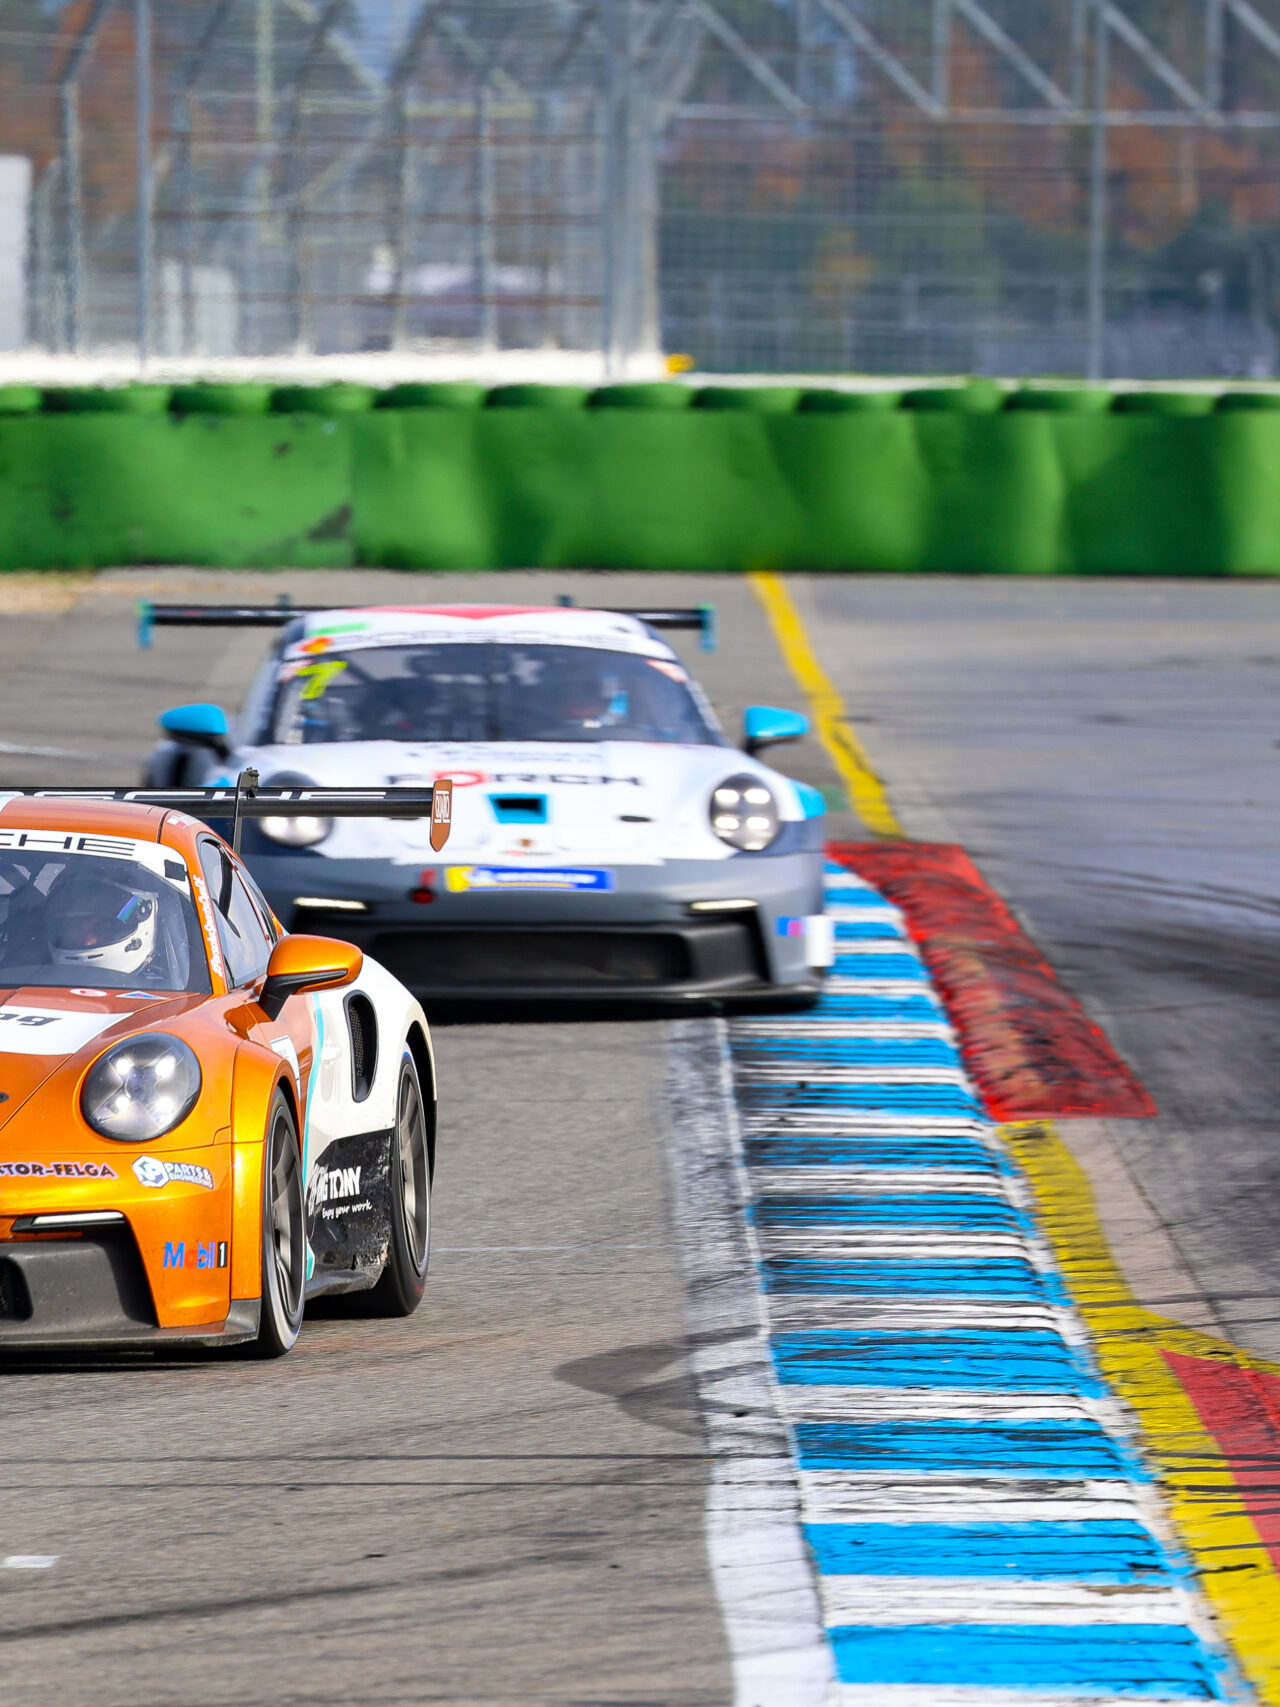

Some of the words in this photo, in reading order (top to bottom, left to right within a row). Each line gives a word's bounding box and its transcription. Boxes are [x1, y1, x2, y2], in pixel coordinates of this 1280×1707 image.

[297, 661, 348, 699] 7
[329, 1166, 361, 1199] TONY
[335, 1205, 350, 1219] your
[351, 1199, 373, 1213] work
[218, 1242, 227, 1268] 1
